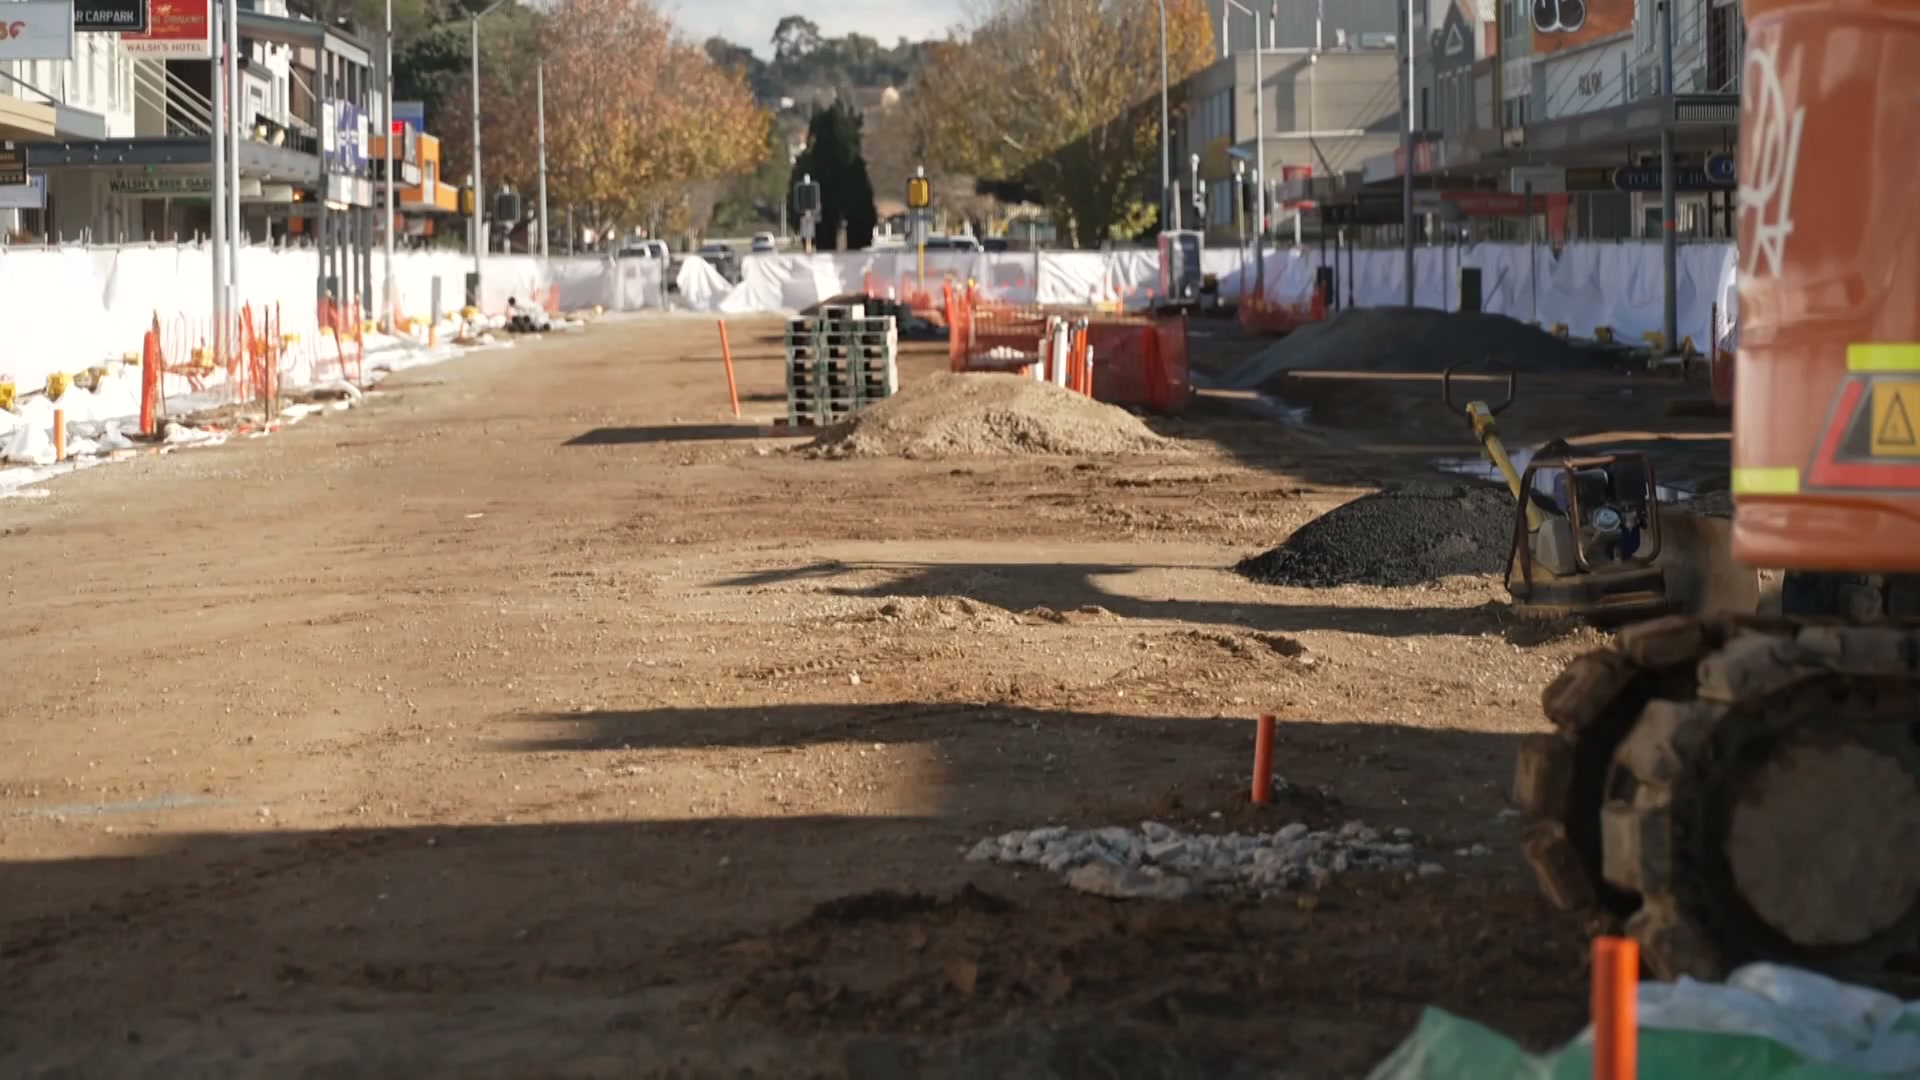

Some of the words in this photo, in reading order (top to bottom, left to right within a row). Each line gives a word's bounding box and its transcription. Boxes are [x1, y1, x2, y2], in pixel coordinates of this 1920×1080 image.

[85, 11, 134, 22] CARPARK
[127, 43, 169, 53] WALSH'S
[172, 43, 203, 52] HOTEL
